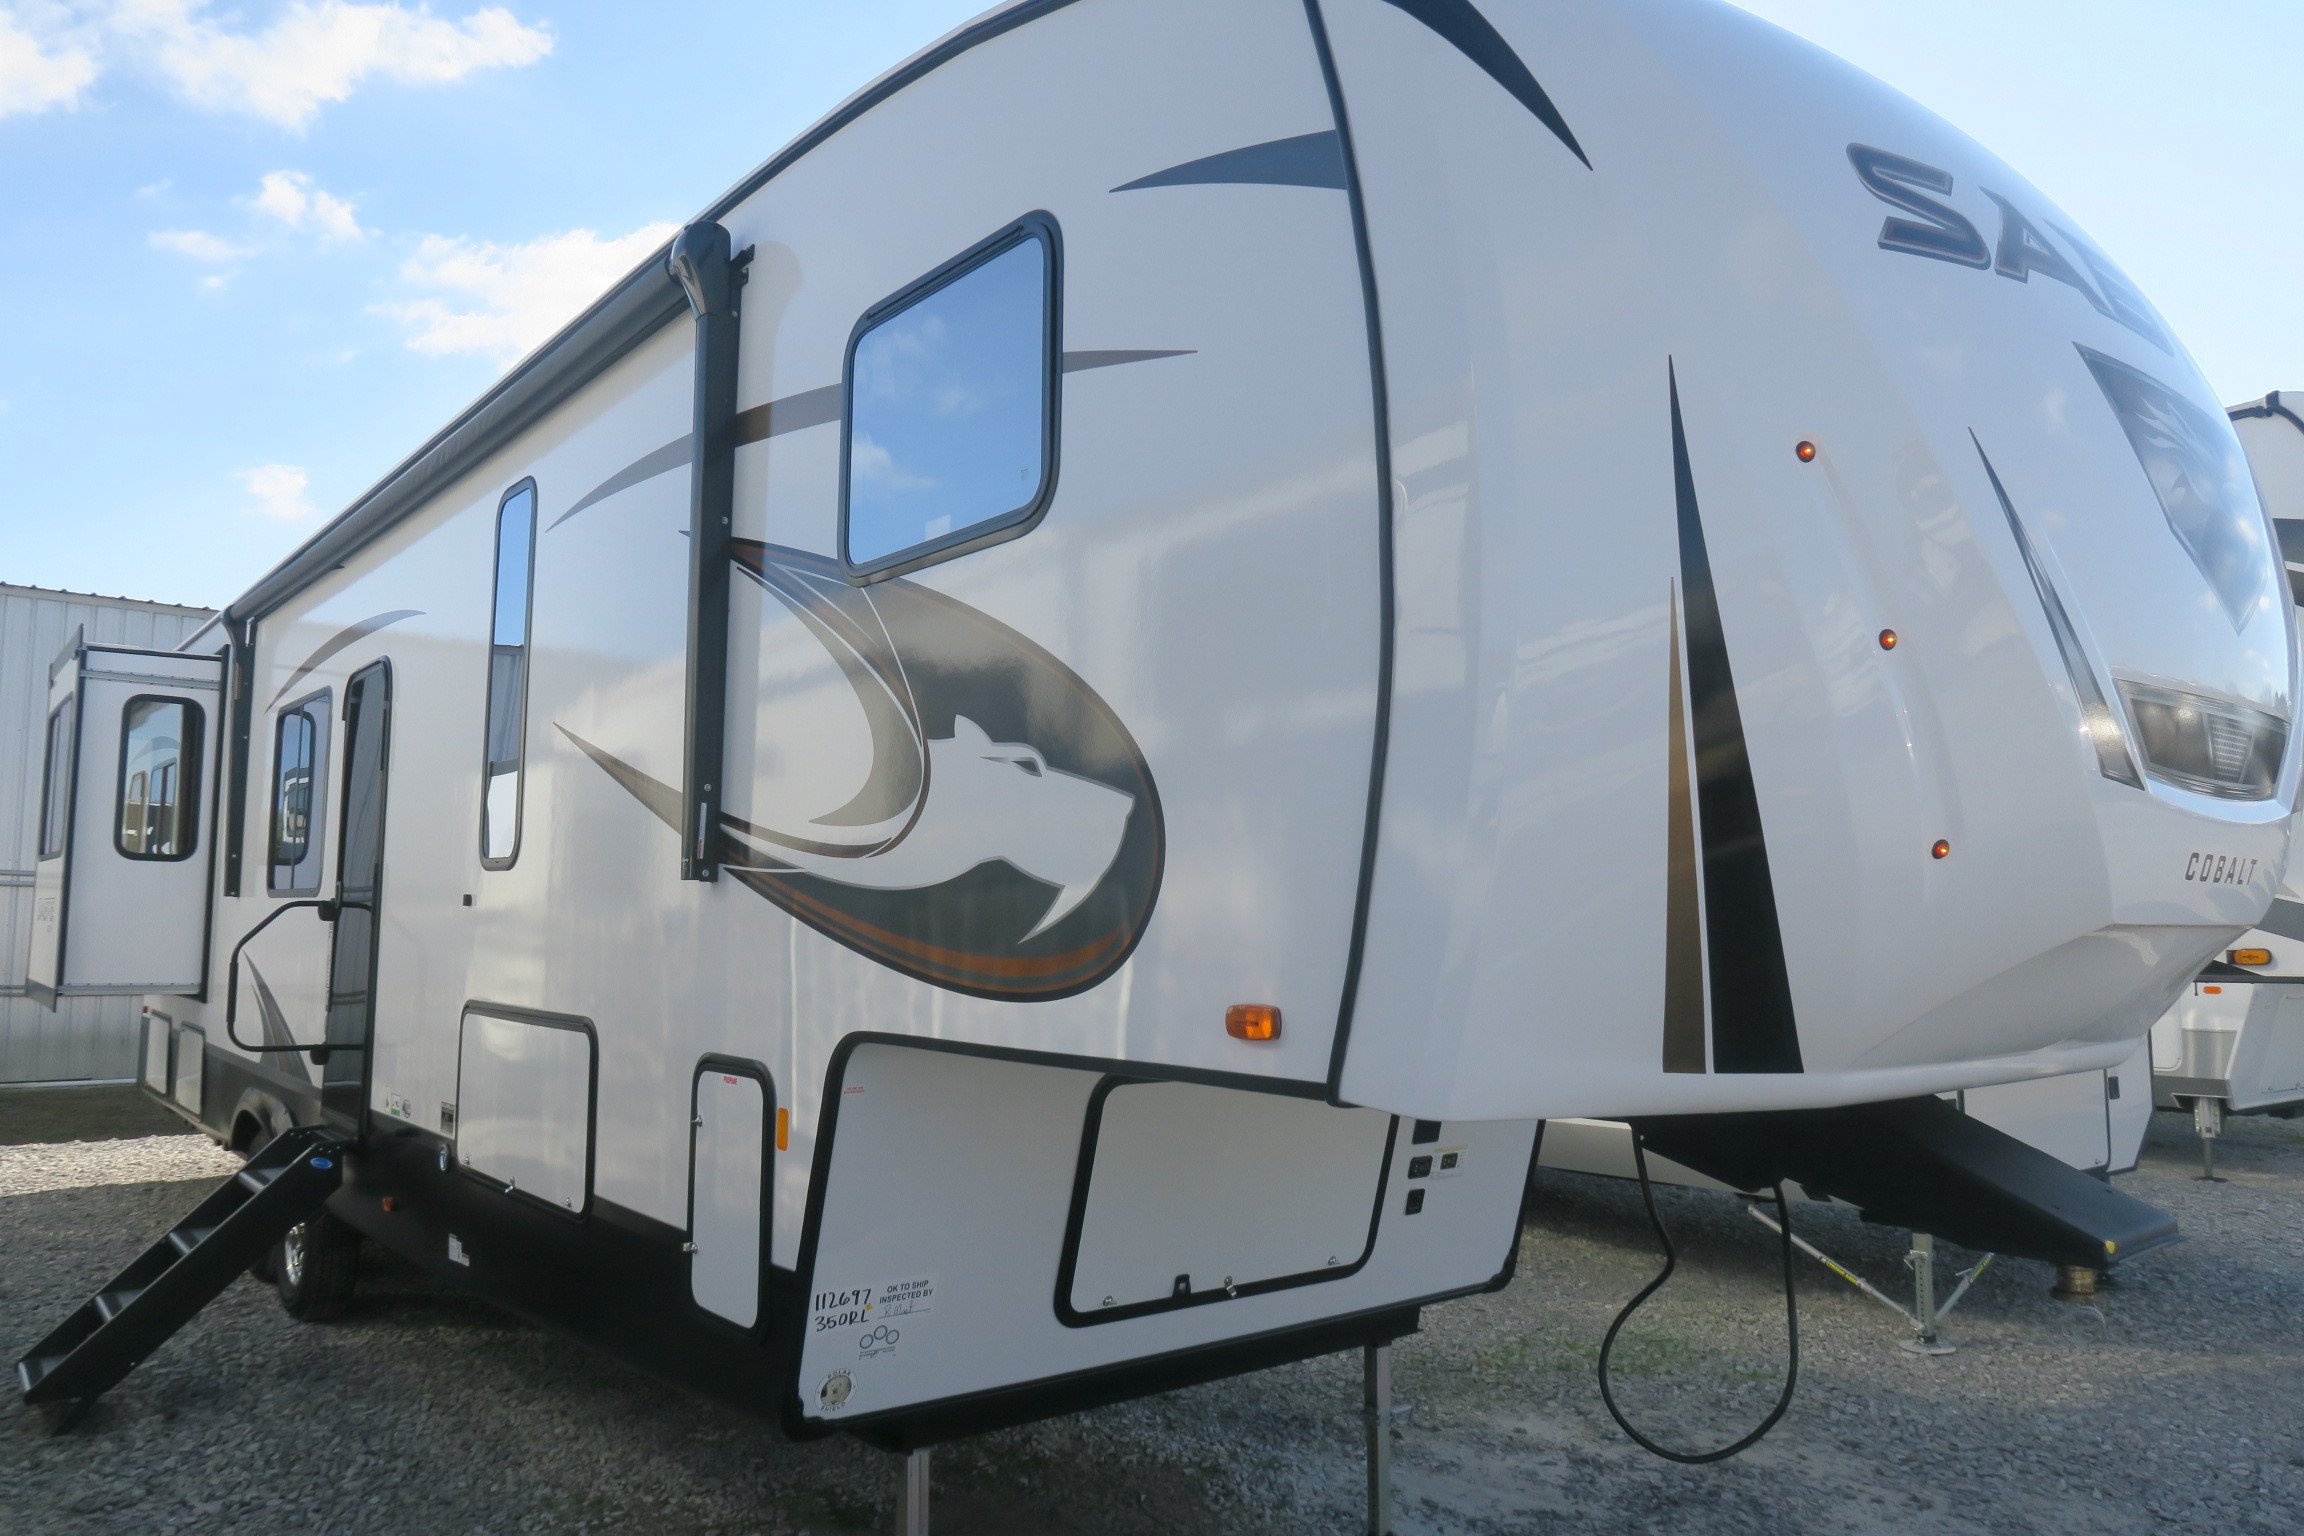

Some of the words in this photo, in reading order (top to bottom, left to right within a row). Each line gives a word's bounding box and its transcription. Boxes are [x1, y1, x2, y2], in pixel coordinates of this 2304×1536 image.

[2184, 852, 2258, 885] COBALT
[880, 1291, 921, 1304] INSPECTED
[923, 1288, 934, 1297] BY
[887, 1285, 898, 1293] OK
[901, 1282, 910, 1291] TO
[912, 1280, 929, 1289] SHIP
[815, 1289, 871, 1311] 112697
[814, 1309, 869, 1332] 350RL
